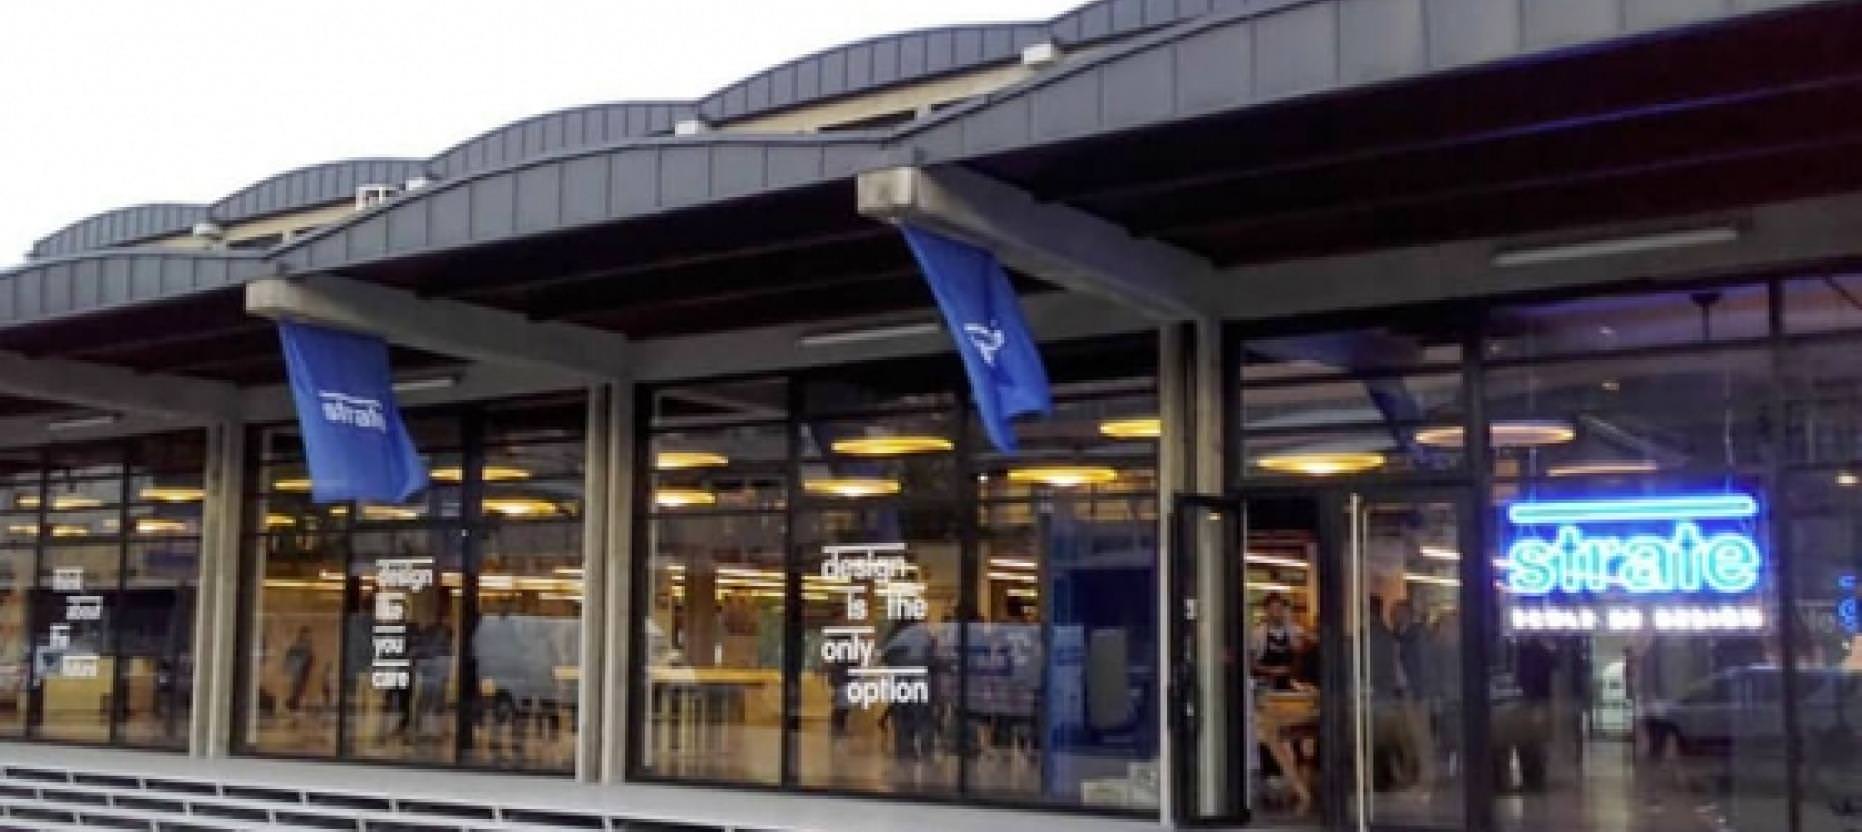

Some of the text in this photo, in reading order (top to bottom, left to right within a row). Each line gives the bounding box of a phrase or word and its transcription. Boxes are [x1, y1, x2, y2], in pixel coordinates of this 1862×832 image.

[821, 549, 906, 583] design
[1508, 522, 1760, 594] strate
[848, 590, 867, 619] is
[373, 633, 405, 656] you
[821, 632, 875, 667] only
[848, 673, 929, 710] option
